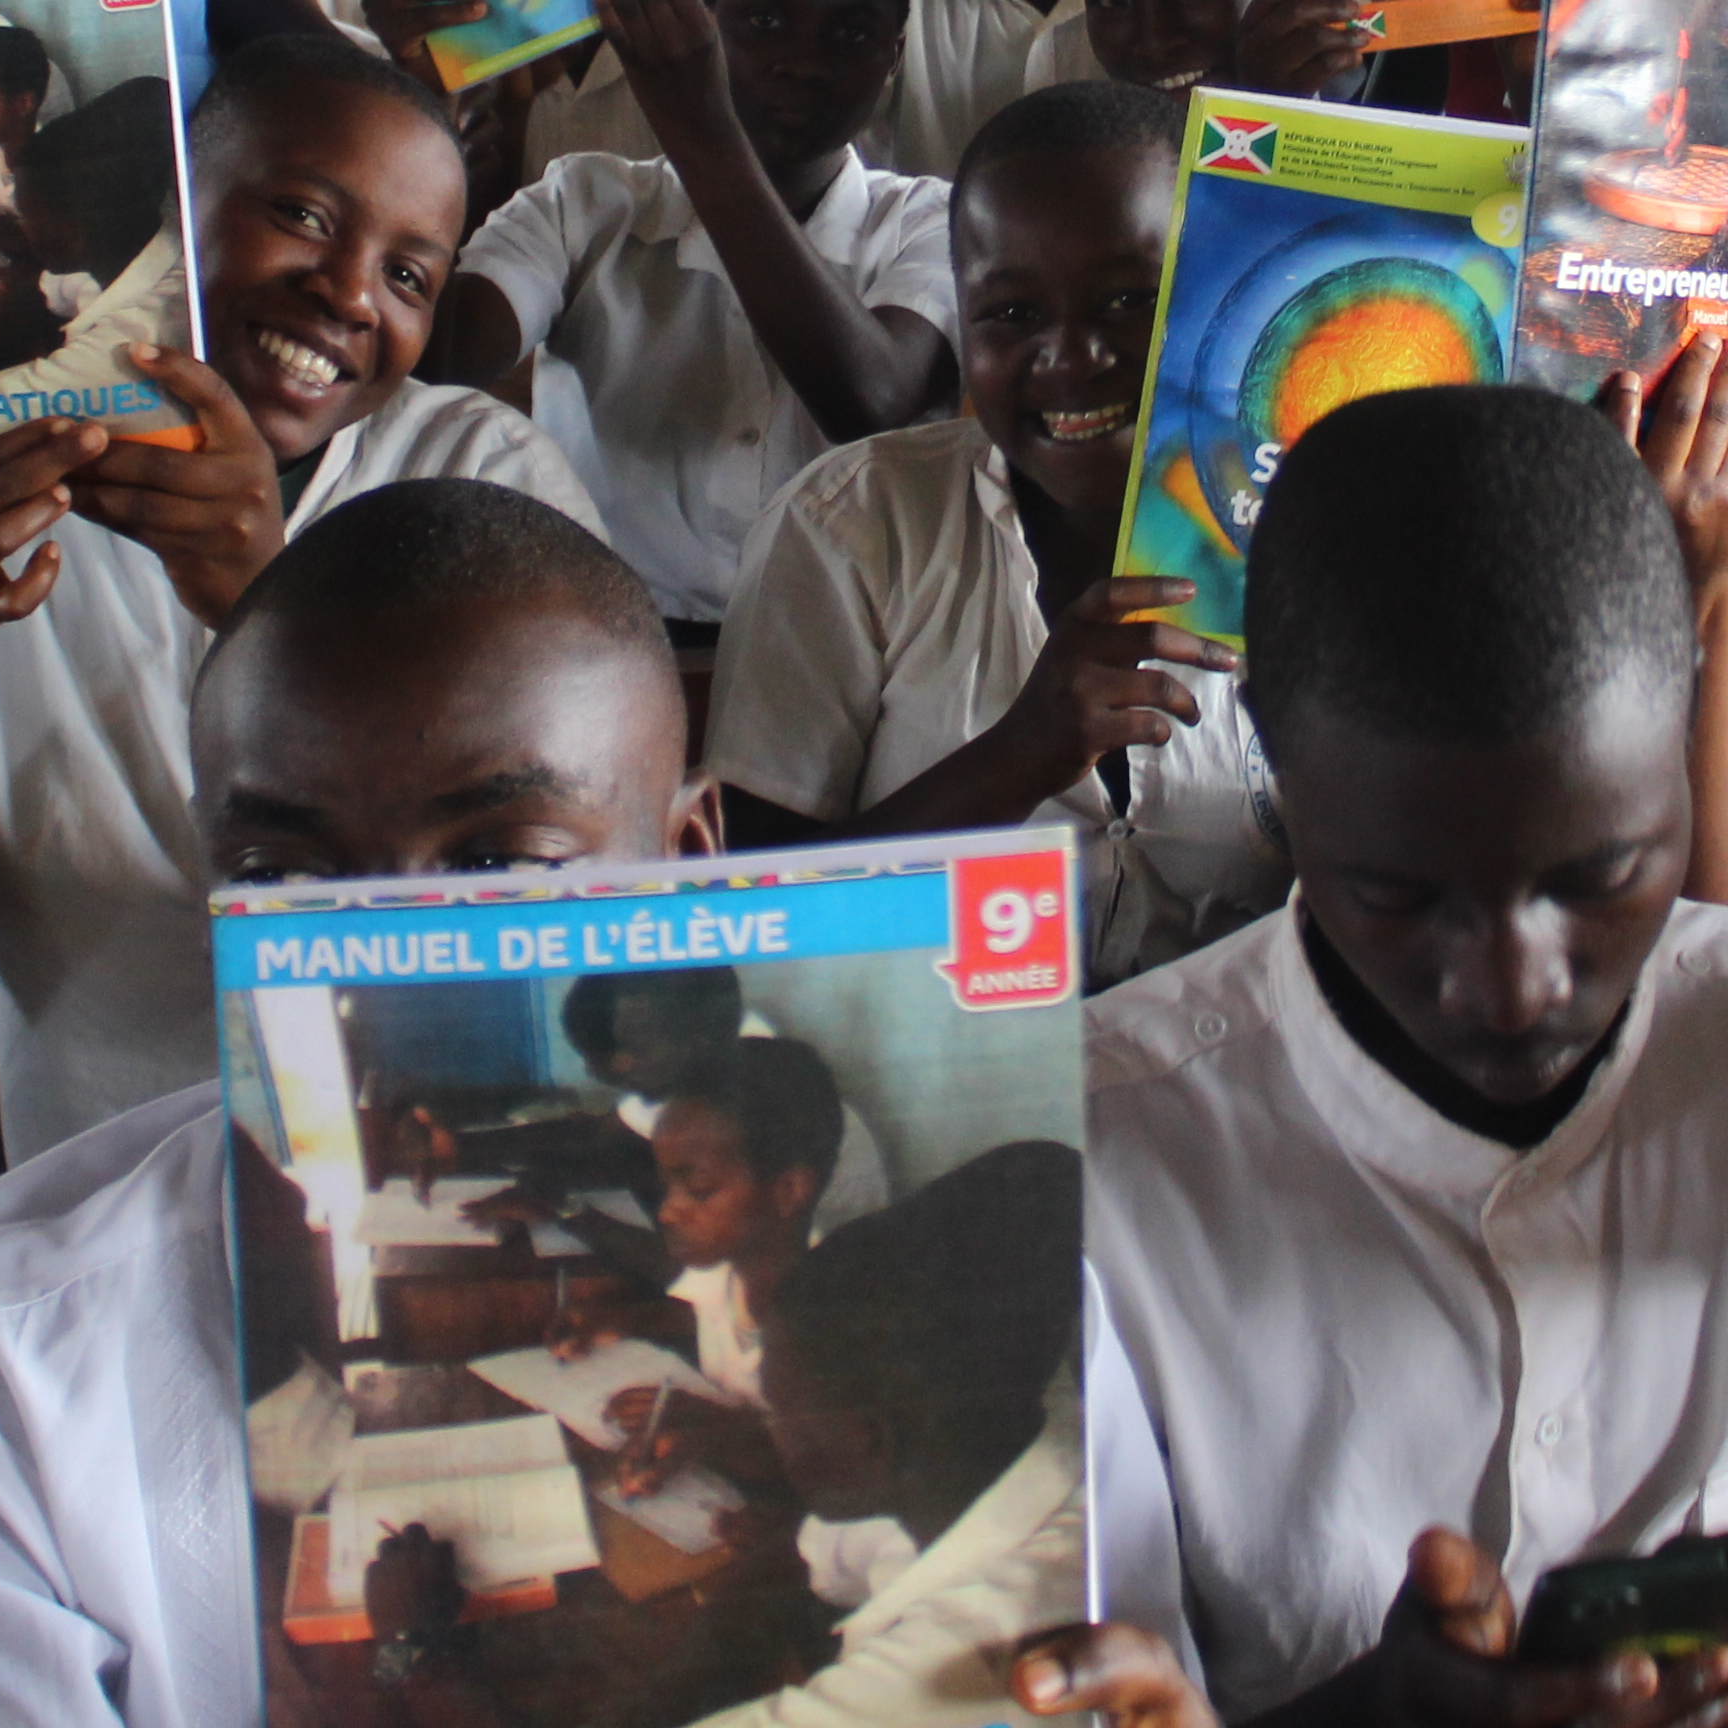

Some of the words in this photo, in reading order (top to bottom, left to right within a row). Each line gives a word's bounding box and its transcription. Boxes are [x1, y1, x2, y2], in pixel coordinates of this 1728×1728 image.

[1693, 309, 1727, 325] Manuel
[255, 930, 485, 980] MANUEL
[498, 926, 570, 972] DE
[582, 907, 789, 967] L'ÉLÈVE
[980, 892, 1059, 954] 9e
[966, 964, 1058, 995] ANNÉE
